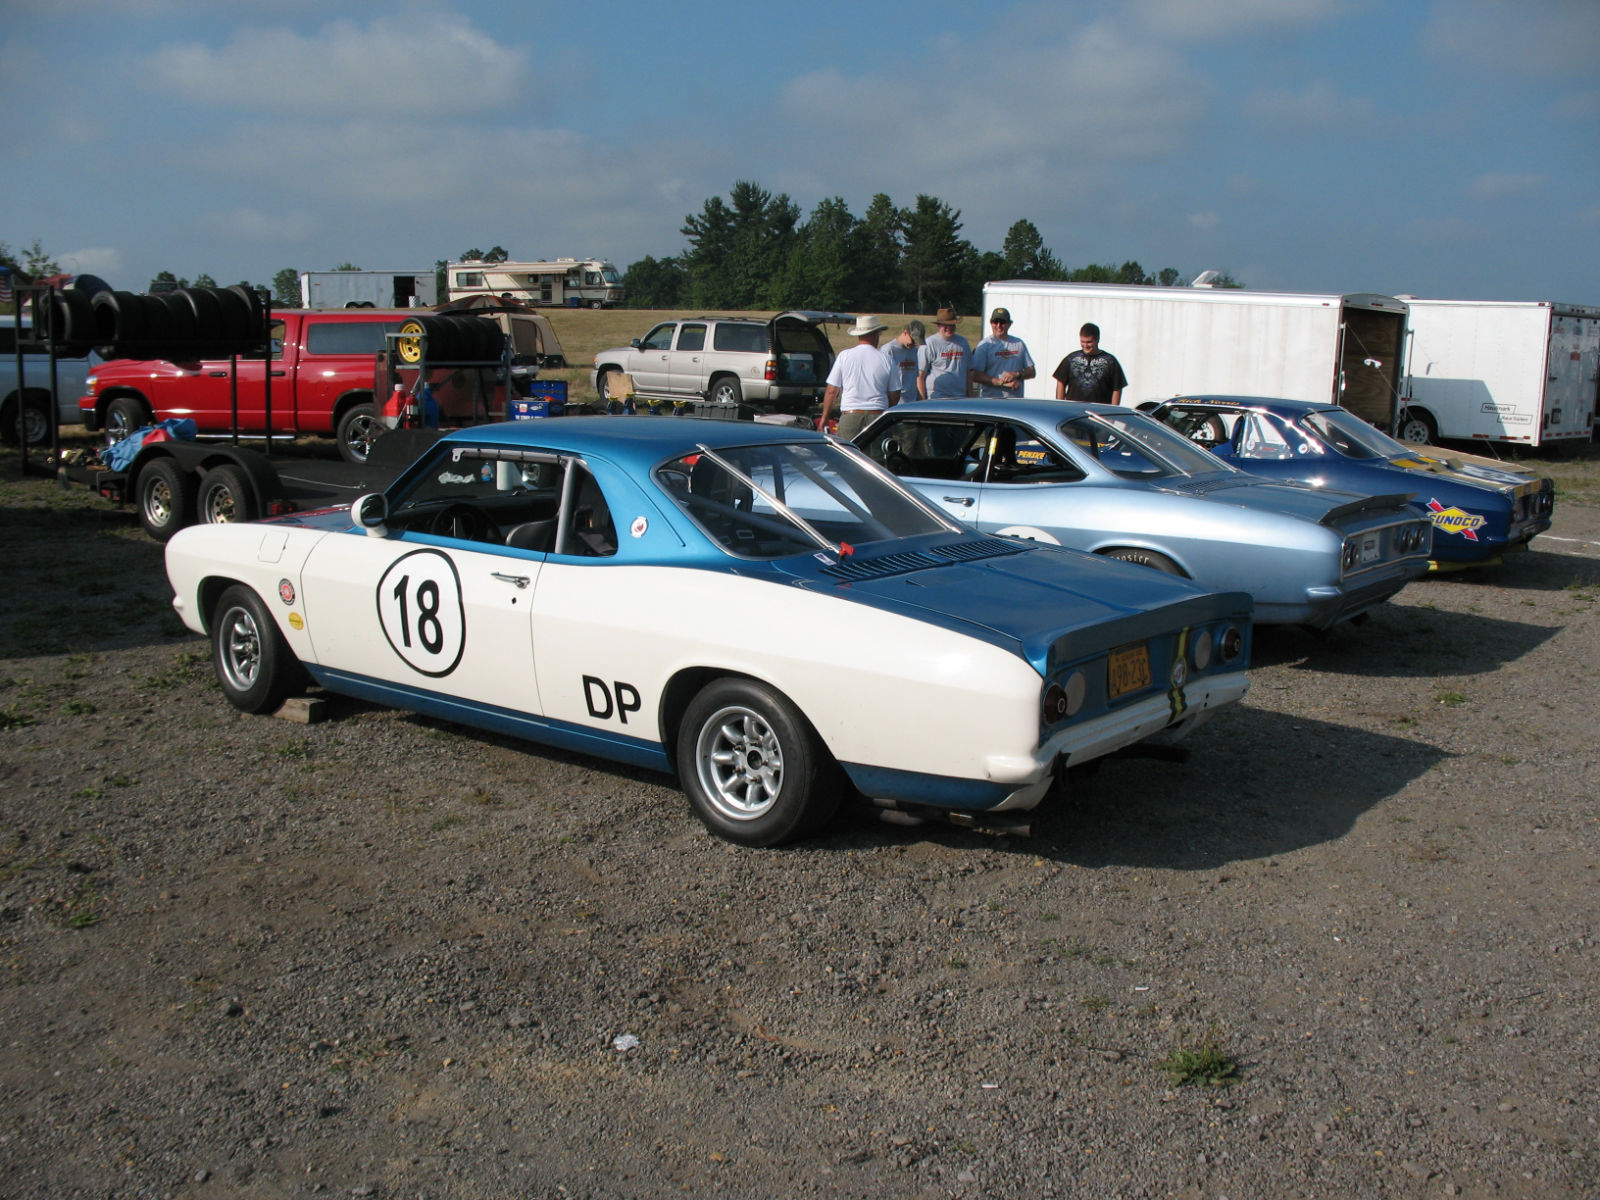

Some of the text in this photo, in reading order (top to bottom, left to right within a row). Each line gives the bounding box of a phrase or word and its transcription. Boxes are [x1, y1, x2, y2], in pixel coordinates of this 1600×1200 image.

[1018, 450, 1046, 460] PENSKE
[1429, 514, 1480, 527] SUNOCO
[393, 575, 443, 655] 18
[582, 674, 642, 725] DP
